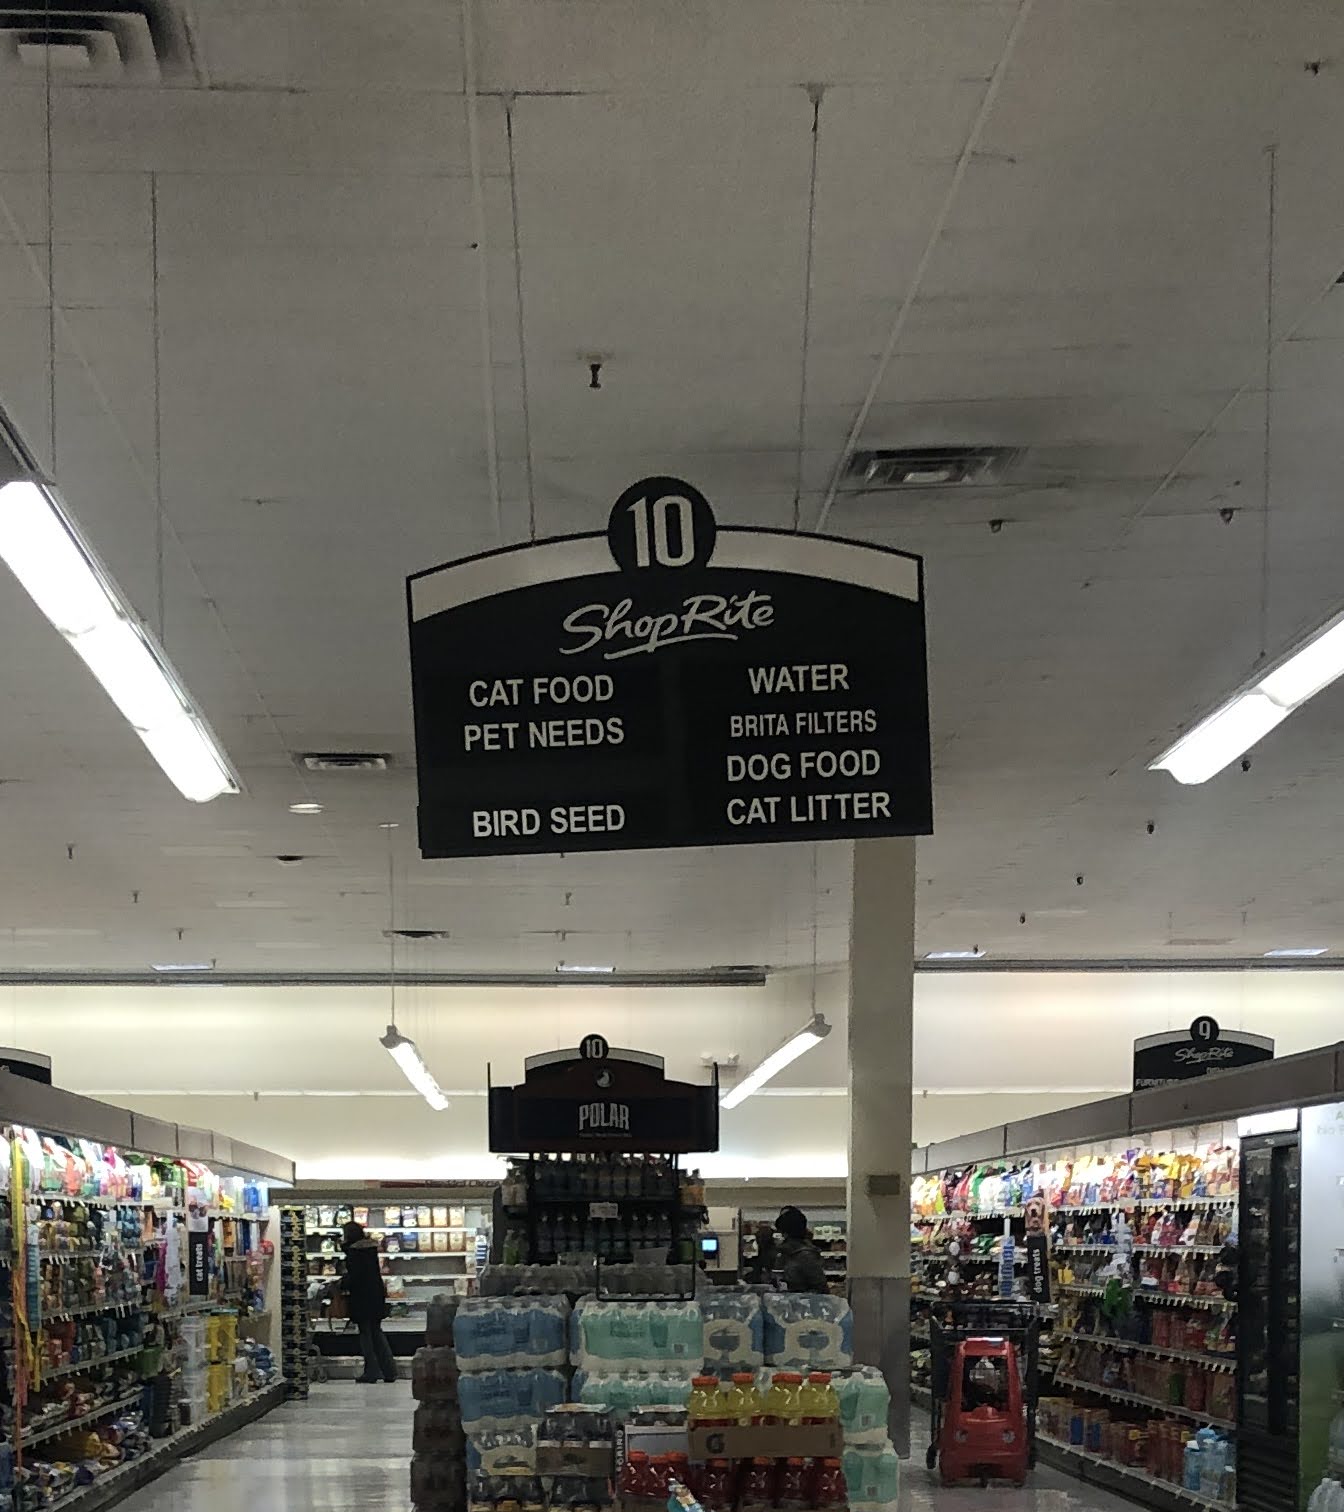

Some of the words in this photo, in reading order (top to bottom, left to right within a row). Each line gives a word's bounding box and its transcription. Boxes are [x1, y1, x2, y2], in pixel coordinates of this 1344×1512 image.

[626, 495, 695, 569] 10
[558, 590, 774, 659] ShopRite
[469, 678, 523, 707] CAT
[534, 675, 614, 703] FOOD
[748, 664, 850, 694] WATER
[464, 722, 520, 751] PET
[529, 718, 625, 747] NEEDS
[730, 712, 789, 738] BRITA
[796, 709, 877, 735] FILTERS
[727, 752, 791, 782] DOG
[800, 749, 880, 778] FOOD
[473, 808, 540, 838] BIRD
[550, 804, 625, 833] SEED
[727, 797, 780, 825] CAT
[790, 791, 891, 822] LITTER
[1199, 1020, 1210, 1040] 9
[585, 1039, 603, 1058] 10
[579, 1102, 630, 1131] POLAR
[195, 1243, 203, 1268] treats
[1033, 1248, 1041, 1274] treats
[196, 1268, 204, 1282] cat
[1033, 1275, 1044, 1293] dog
